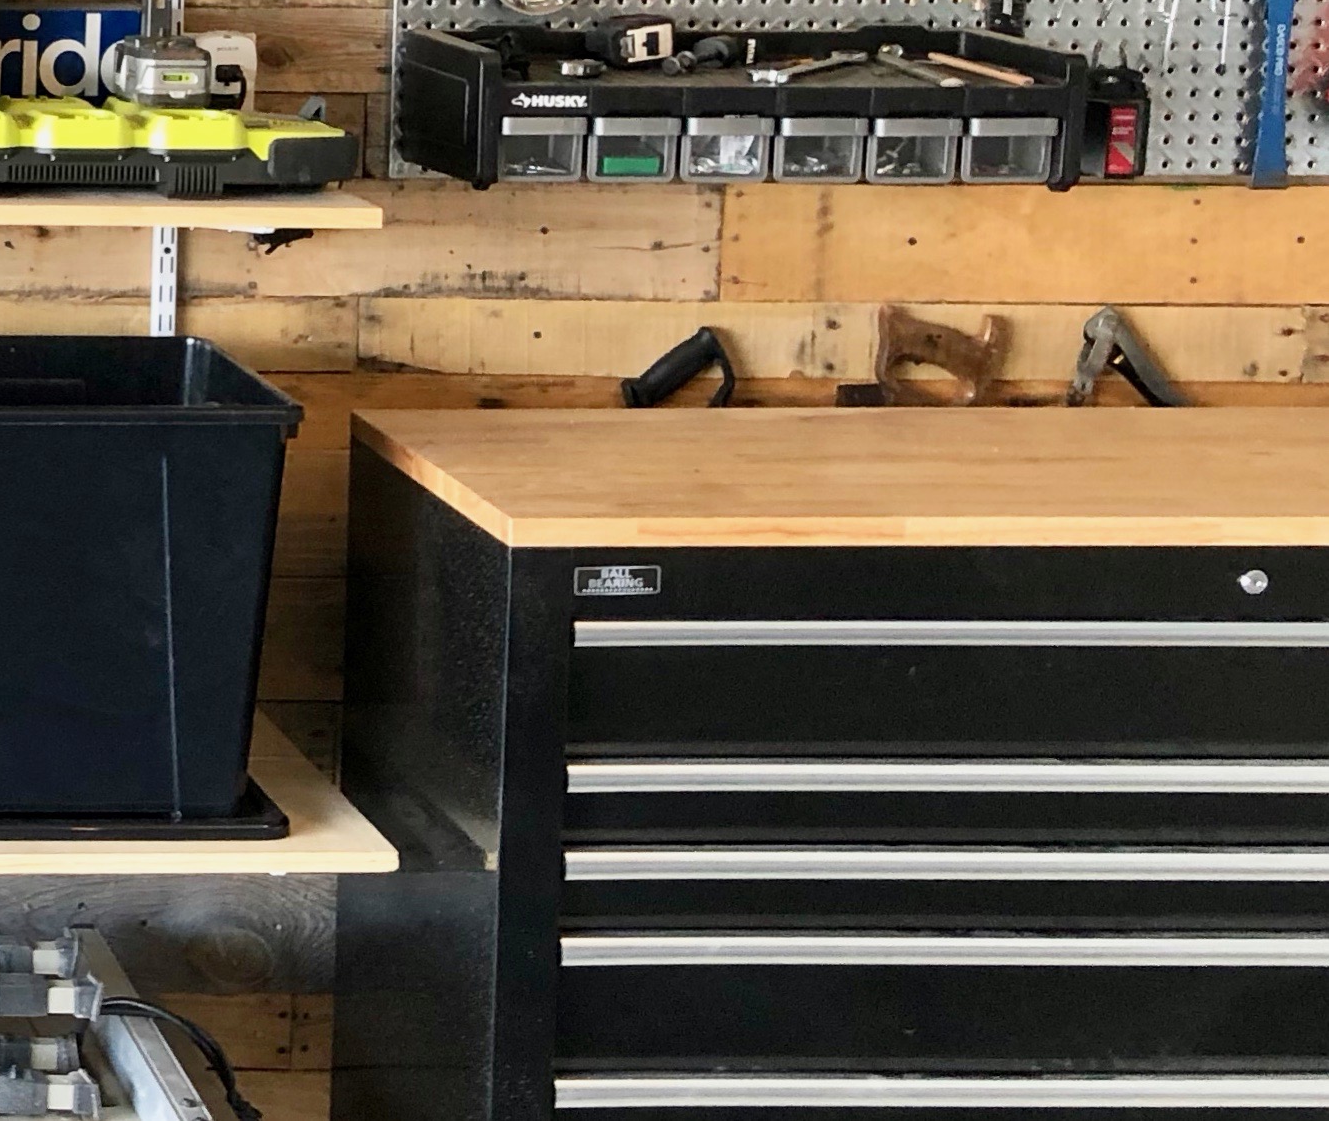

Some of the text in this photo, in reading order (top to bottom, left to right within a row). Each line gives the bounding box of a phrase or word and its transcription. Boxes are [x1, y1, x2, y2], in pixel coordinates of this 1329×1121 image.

[531, 95, 587, 108] HUSKY
[601, 568, 633, 578] BALL
[588, 578, 644, 588] BEARING
